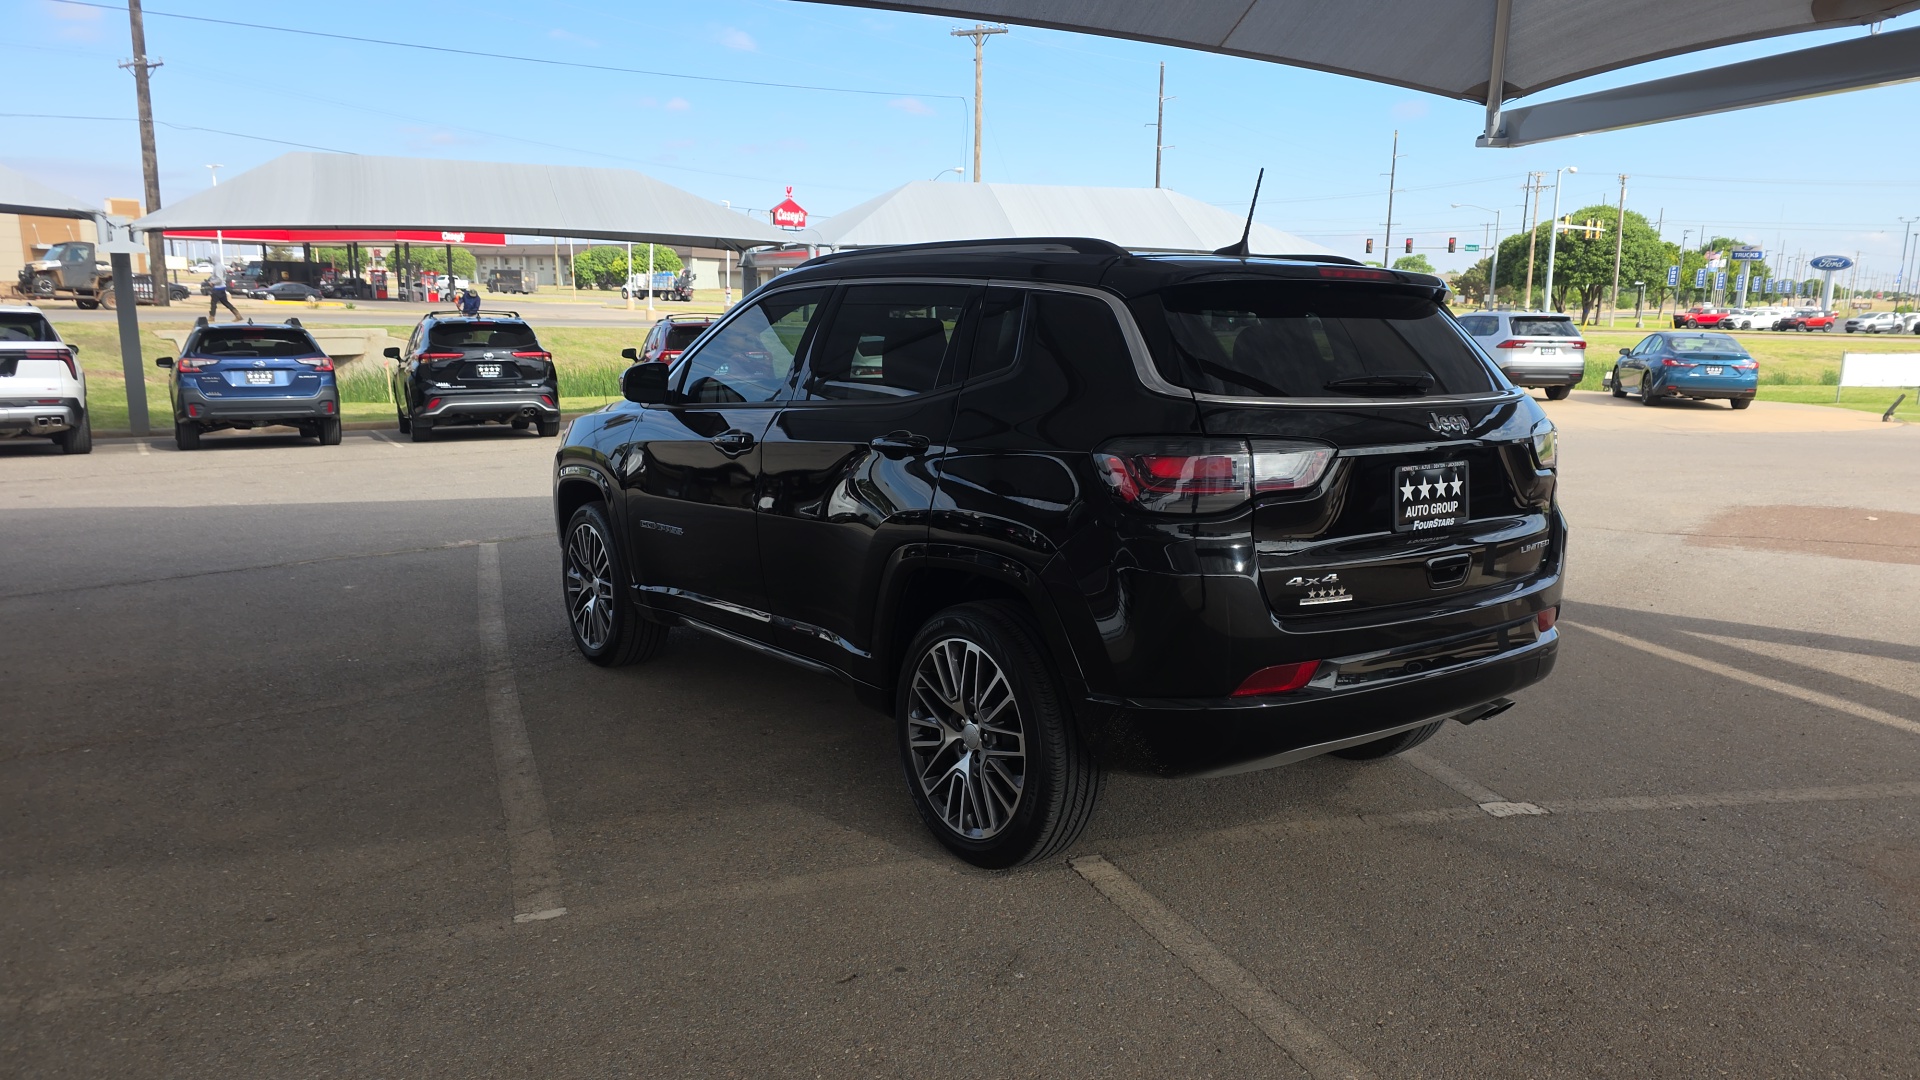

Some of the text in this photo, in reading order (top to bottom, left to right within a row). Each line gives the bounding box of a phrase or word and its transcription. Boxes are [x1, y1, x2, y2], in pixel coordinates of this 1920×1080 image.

[777, 208, 804, 224] Casey's
[1819, 258, 1845, 267] Ford
[1429, 411, 1470, 434] Jeep
[1405, 500, 1459, 518] AUTO GROUP
[1521, 539, 1550, 553] LIMITED
[1285, 573, 1340, 587] 4x4
